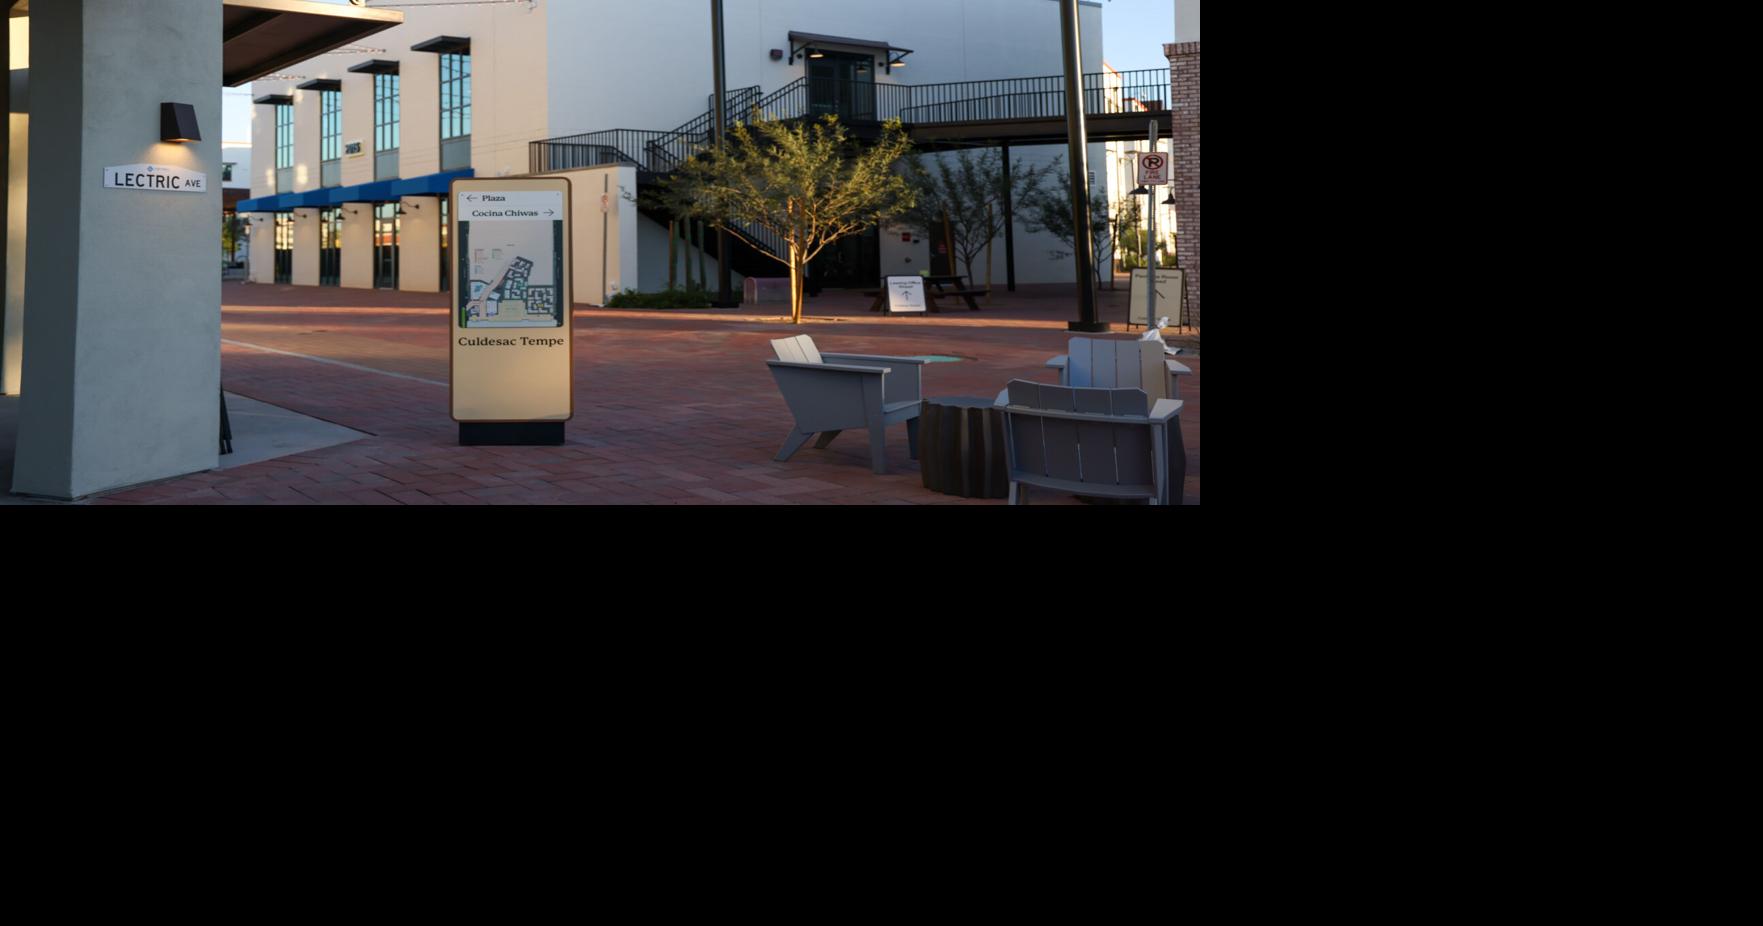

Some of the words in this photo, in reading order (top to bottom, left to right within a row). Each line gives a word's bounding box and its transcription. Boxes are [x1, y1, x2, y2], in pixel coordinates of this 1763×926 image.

[115, 172, 180, 189] LECTRIC
[185, 179, 201, 188] AVE
[482, 194, 506, 202] Plaza
[472, 209, 503, 217] Cocina
[504, 209, 539, 217] Chiwas
[458, 337, 517, 347] Culdesac
[520, 336, 565, 348] Tempe
